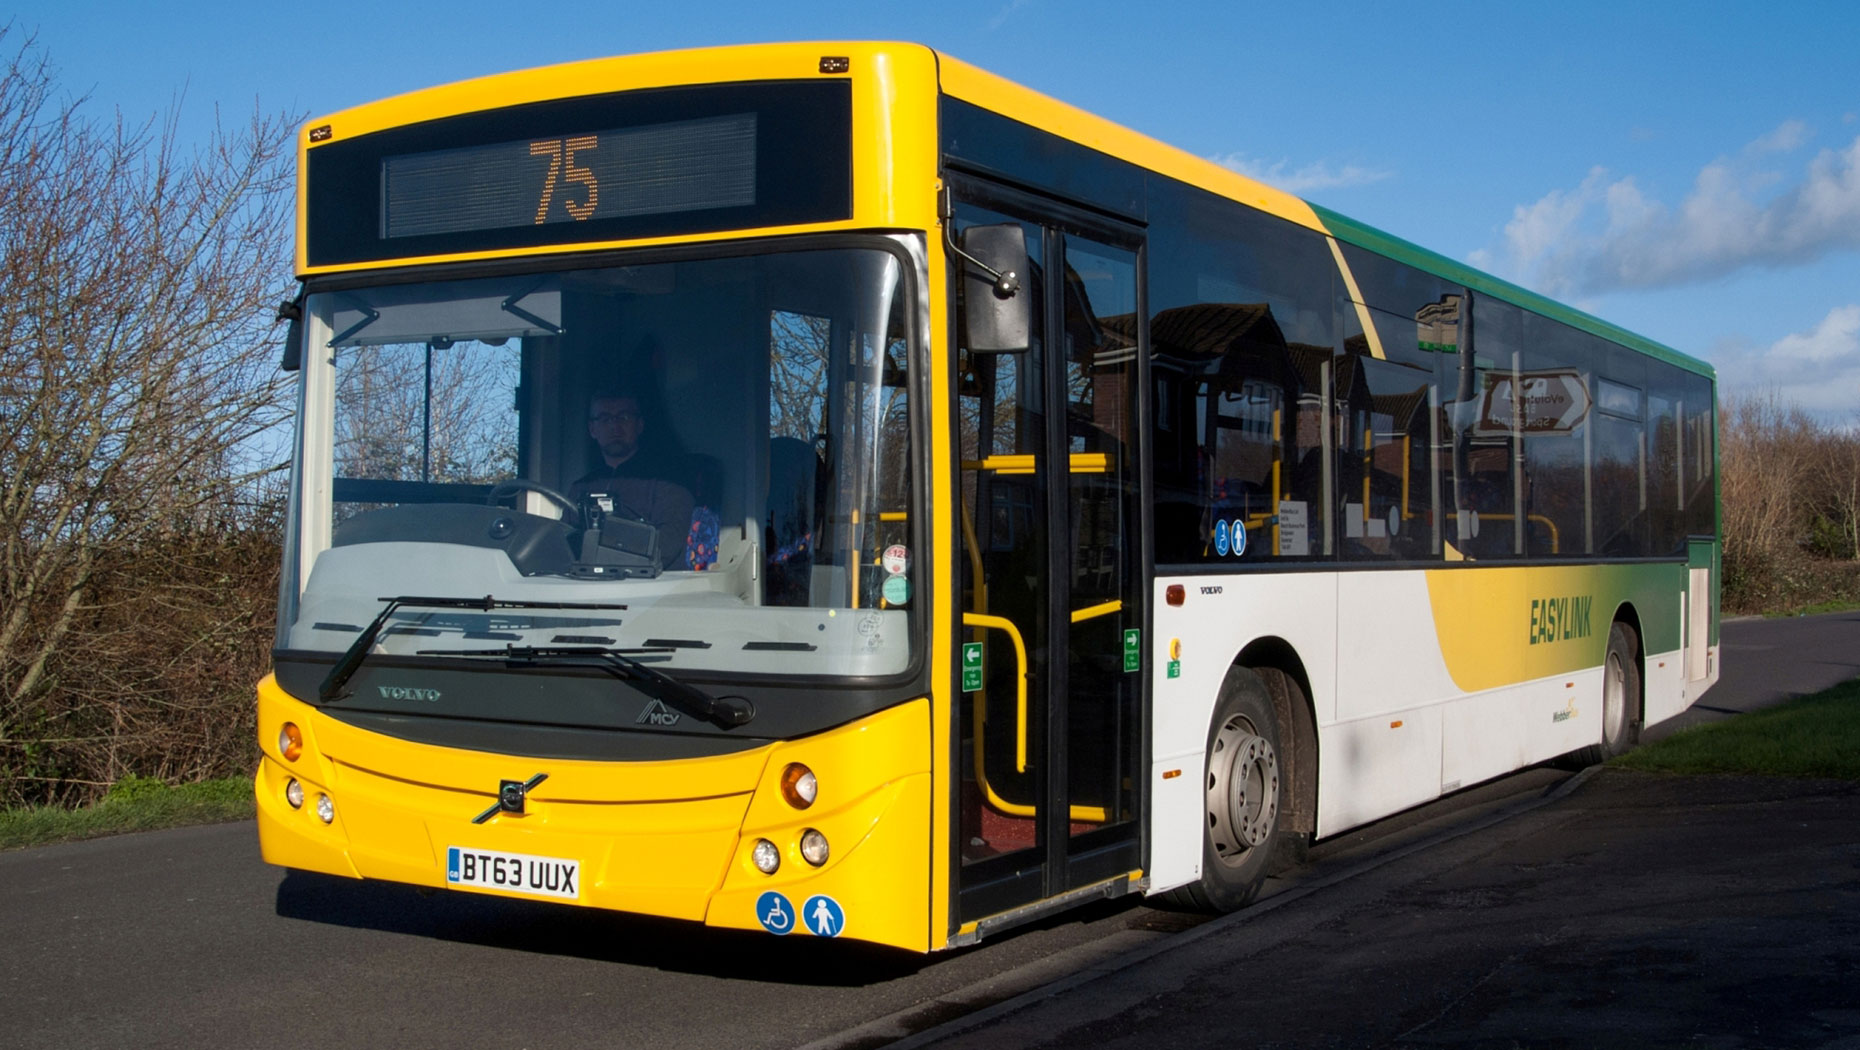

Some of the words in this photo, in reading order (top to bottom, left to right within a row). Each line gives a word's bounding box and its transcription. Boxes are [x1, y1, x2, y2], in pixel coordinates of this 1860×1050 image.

[530, 135, 598, 225] 75
[1199, 586, 1223, 595] VOLVO
[1530, 596, 1592, 645] EASYLINK
[377, 686, 441, 702] VOLVO
[463, 853, 523, 887] BT63
[530, 861, 575, 893] UUX
